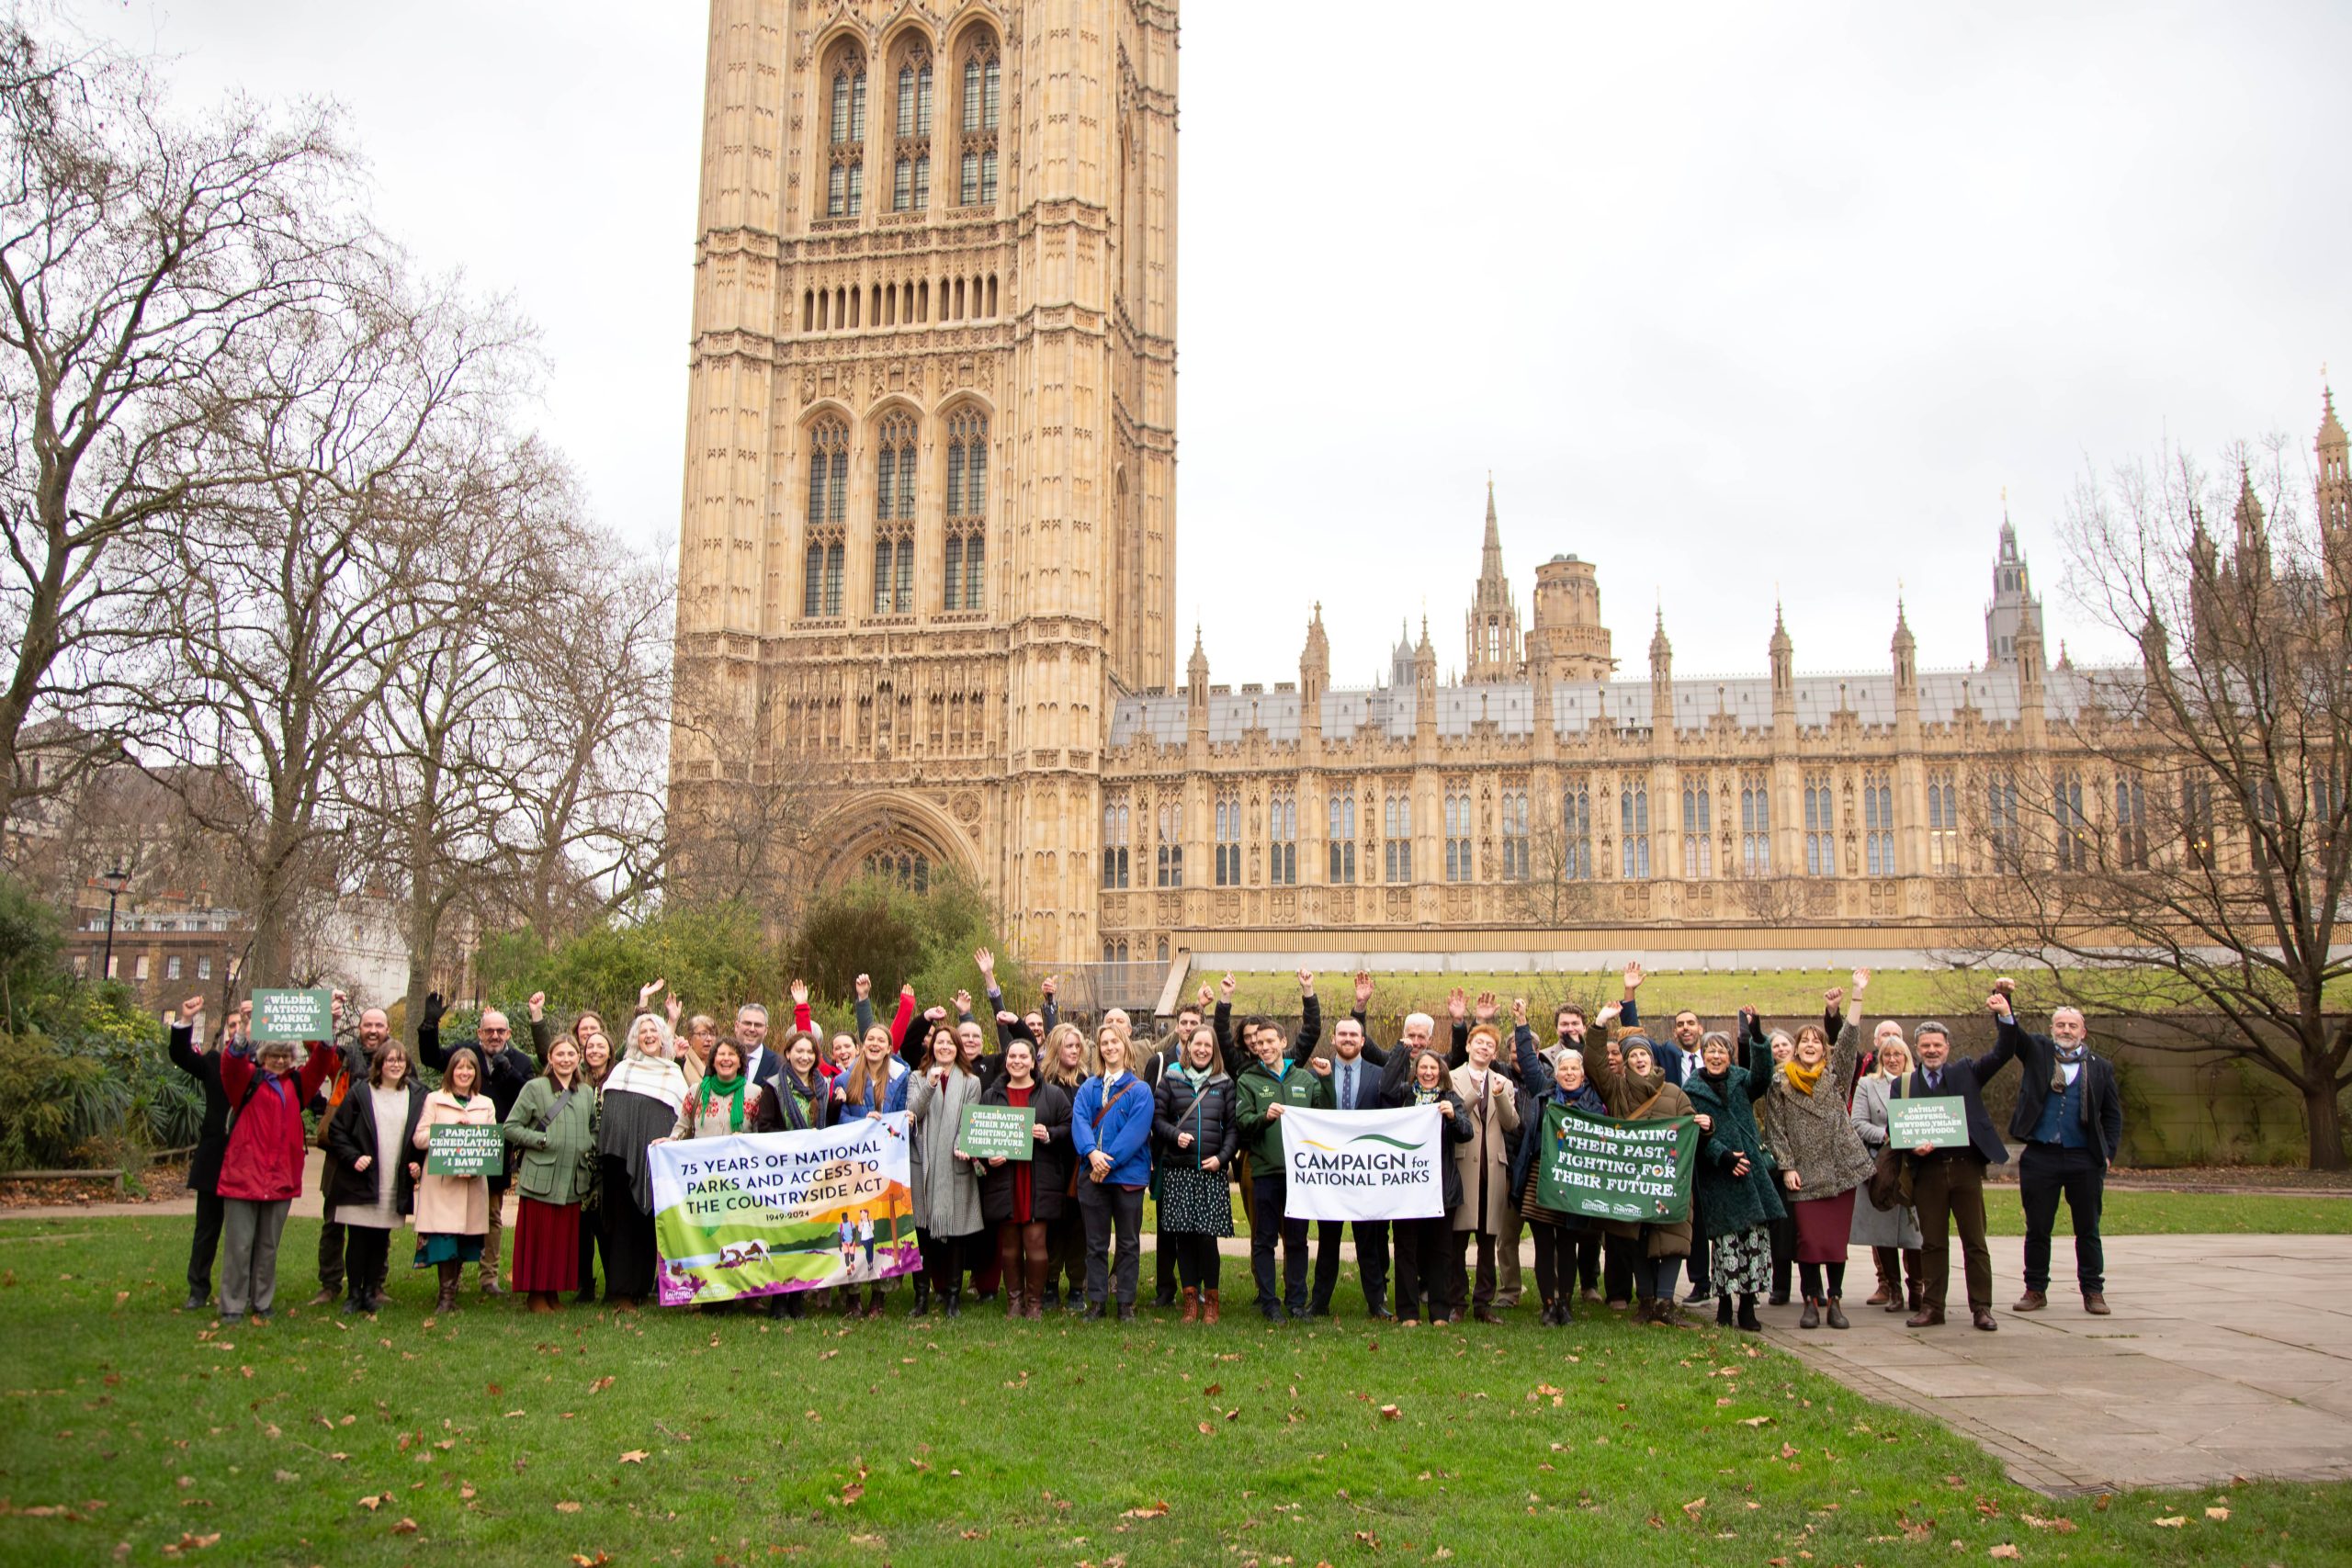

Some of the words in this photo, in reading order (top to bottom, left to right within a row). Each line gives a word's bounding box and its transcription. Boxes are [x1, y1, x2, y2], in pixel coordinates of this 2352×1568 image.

[270, 995, 314, 1004] WILDER
[264, 1005, 321, 1013] NATIONAL
[273, 1014, 311, 1022] PARKS
[268, 1023, 292, 1032] FOR
[294, 1023, 316, 1032] ALL
[972, 1111, 1025, 1122] CELEBRATING
[445, 1128, 490, 1137] PARCIAU
[970, 1128, 1007, 1137] FIGHTING
[1561, 1117, 1678, 1142] CELEBRATING
[967, 1136, 991, 1145] THEIR
[1566, 1135, 1618, 1156] THEIR
[432, 1147, 457, 1156] MWY
[454, 1158, 483, 1167] BAWB
[681, 1163, 698, 1177] 75
[704, 1156, 760, 1174] YEARS
[764, 1154, 789, 1168] OF
[795, 1140, 881, 1166] NATIONAL
[1294, 1152, 1406, 1170] CAMPAIGN
[1411, 1156, 1430, 1168] for
[1557, 1151, 1637, 1175] FIGHTING
[1641, 1163, 1677, 1179] FOR
[687, 1178, 741, 1195] PARKS
[746, 1173, 784, 1189] AND
[790, 1165, 853, 1185] ACCESS
[857, 1159, 879, 1174] TO
[1295, 1171, 1376, 1186] NATIONAL
[1382, 1170, 1430, 1186] PARKS
[1551, 1167, 1601, 1190] THEIR
[1606, 1178, 1677, 1198] FUTURE.
[686, 1199, 720, 1214] THE
[726, 1185, 848, 1211] COUNTRYSIDE
[854, 1178, 883, 1193] ACT
[765, 1210, 809, 1223] 1949-2024
